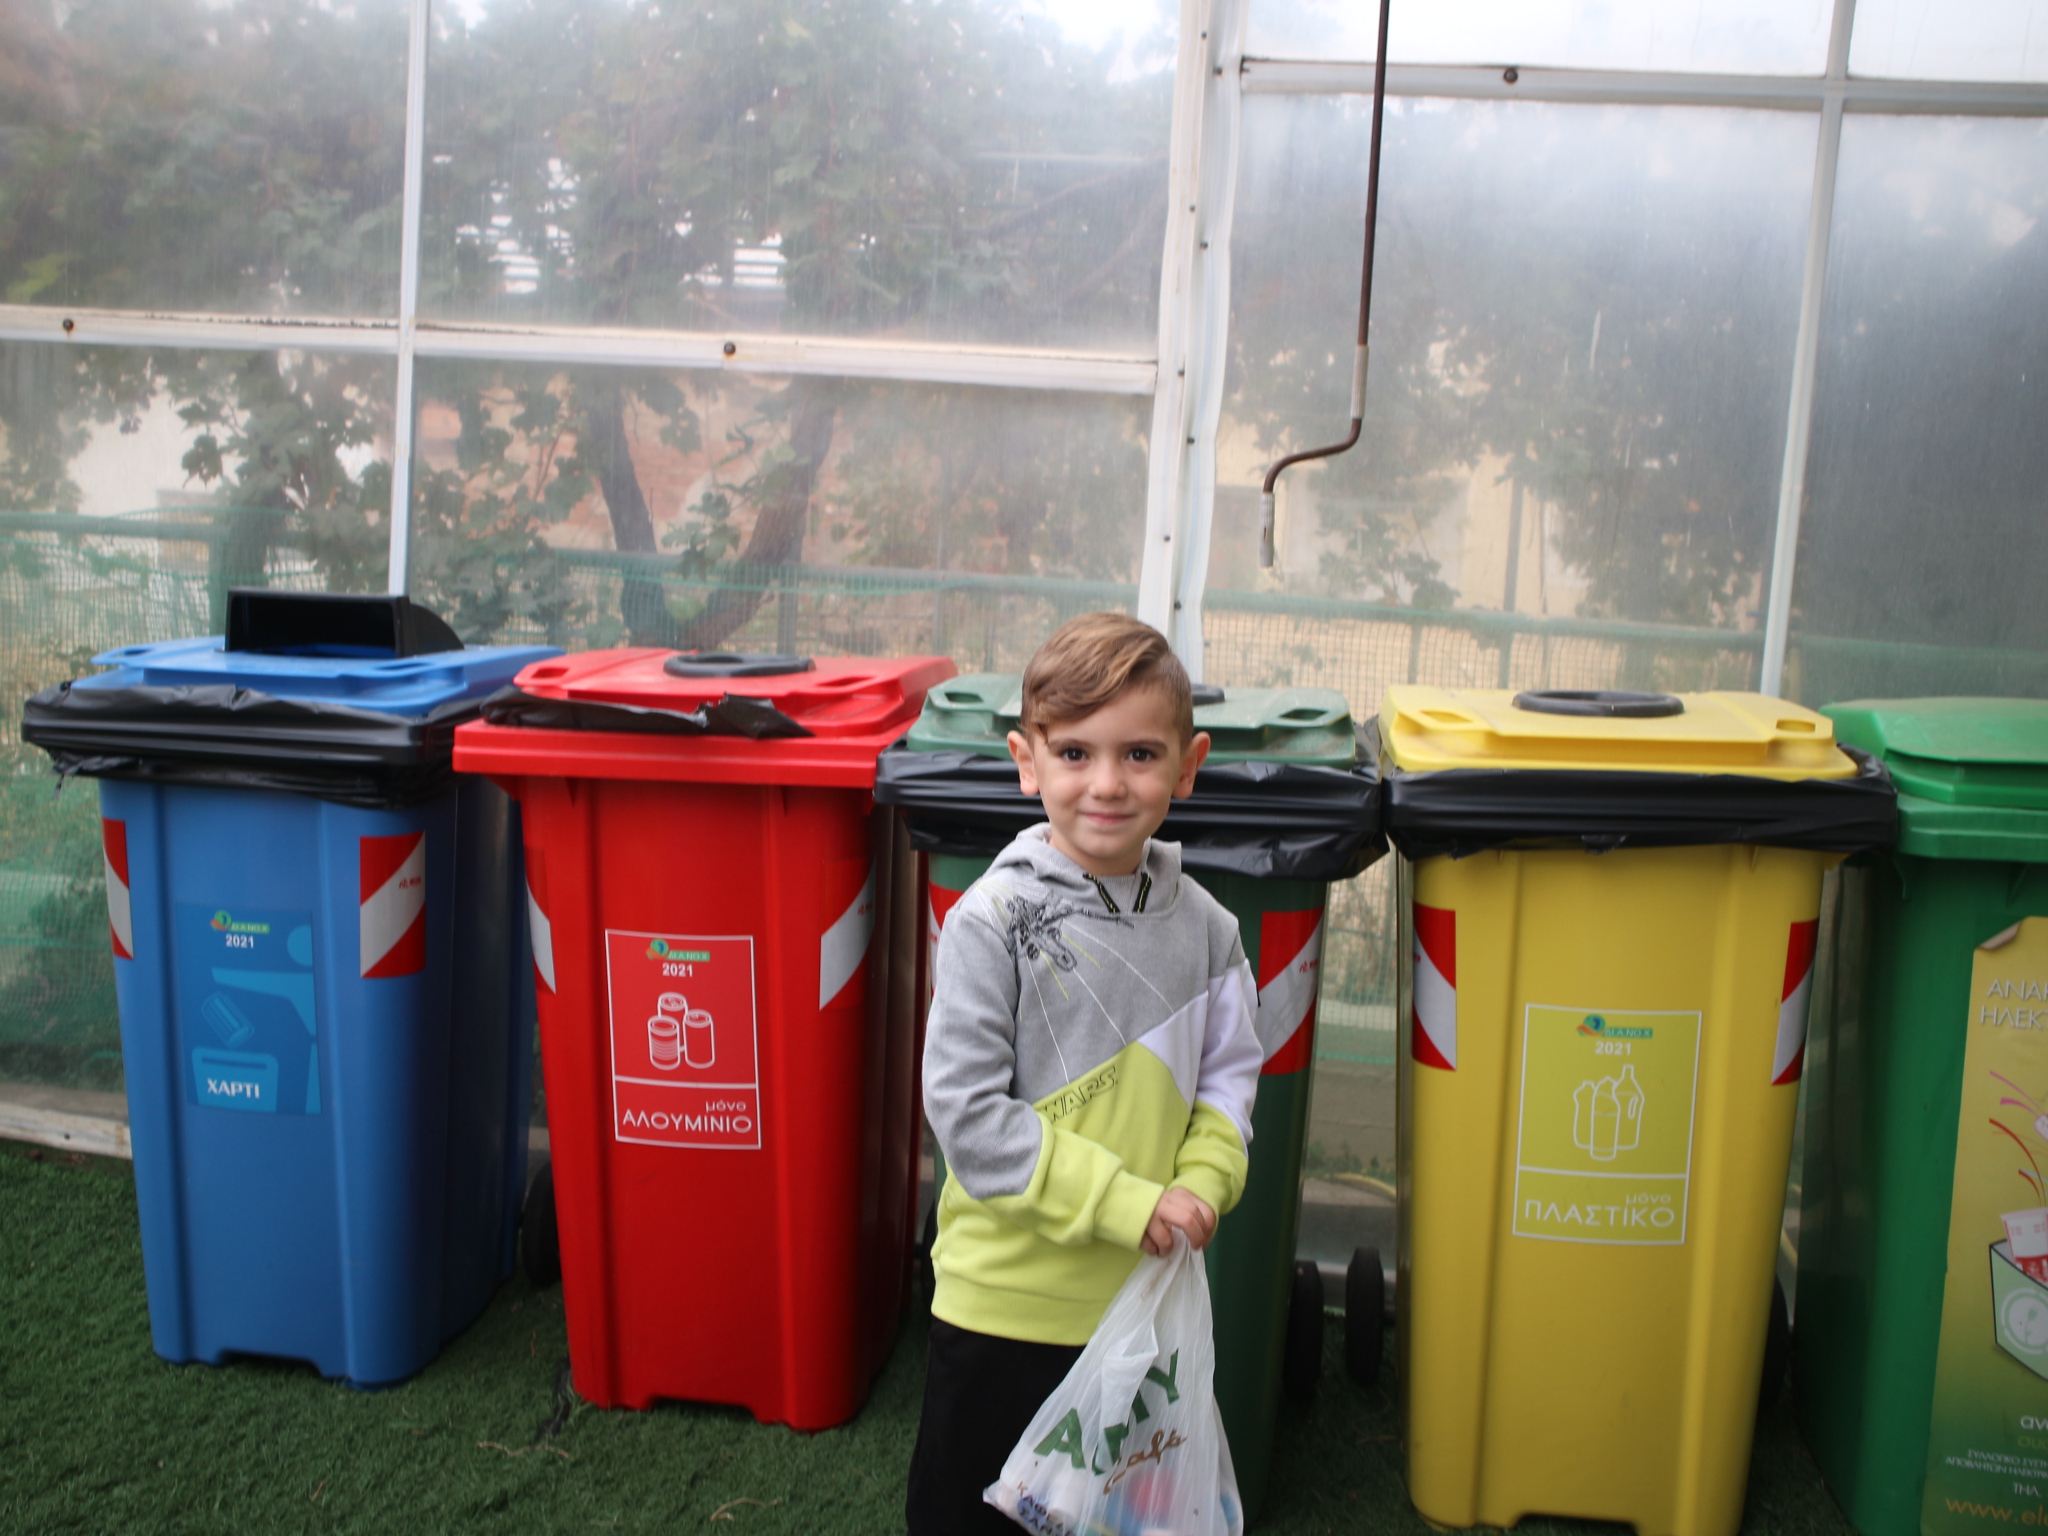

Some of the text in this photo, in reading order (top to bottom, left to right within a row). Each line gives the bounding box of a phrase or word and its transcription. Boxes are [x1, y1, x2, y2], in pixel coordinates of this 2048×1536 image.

[225, 933, 254, 949] 2021
[662, 962, 693, 978] 2021
[1594, 1041, 1632, 1056] 2021
[206, 1077, 260, 1099] ΧΑΡΤΙ
[705, 1099, 747, 1113] μόνο
[622, 1108, 752, 1134] ΑΛΟΥΜΙΝΙΟ
[1626, 1193, 1672, 1206] μόνο
[1525, 1199, 1675, 1228] ΠΛΑΣΤΙΚΟ
